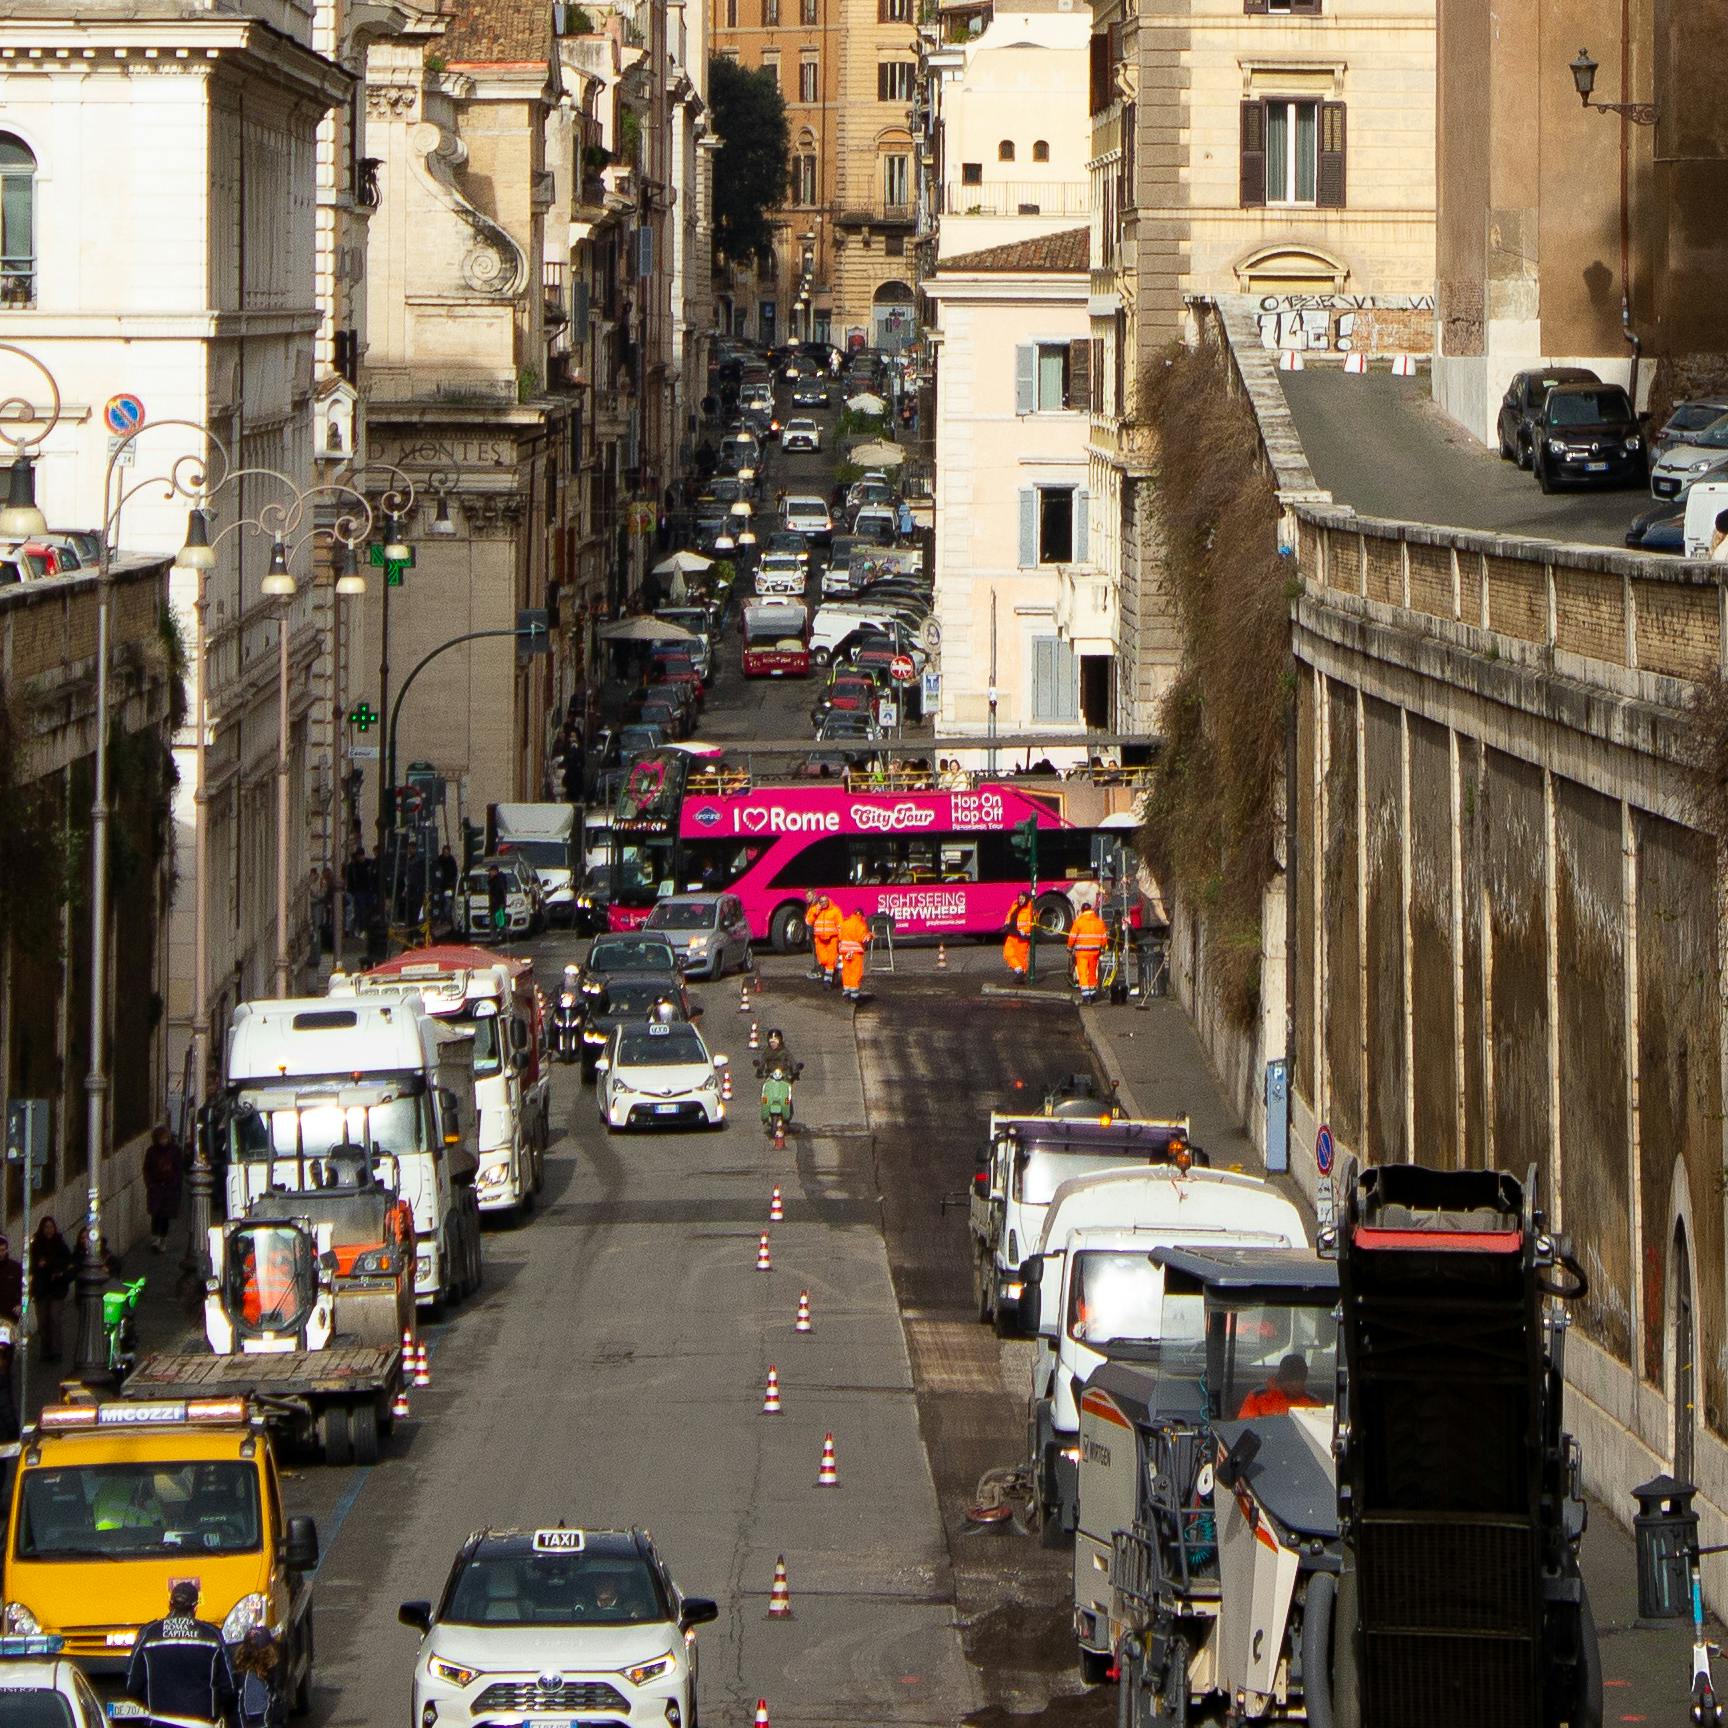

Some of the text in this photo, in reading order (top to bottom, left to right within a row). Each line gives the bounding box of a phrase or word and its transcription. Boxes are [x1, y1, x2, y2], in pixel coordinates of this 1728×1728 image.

[400, 442, 503, 462] MONTES
[951, 793, 1002, 809] Hop On
[733, 808, 739, 832] I
[771, 807, 840, 832] Rome
[851, 803, 934, 831] City Tour
[951, 806, 1004, 823] Hop Off
[877, 892, 966, 908] SIGHTSEEING
[1274, 1068, 1283, 1080] P
[101, 1407, 180, 1422] MICOZZI
[542, 1534, 575, 1546] TAXI
[162, 1624, 189, 1632] ROMA
[163, 1617, 195, 1626] POLIZIA
